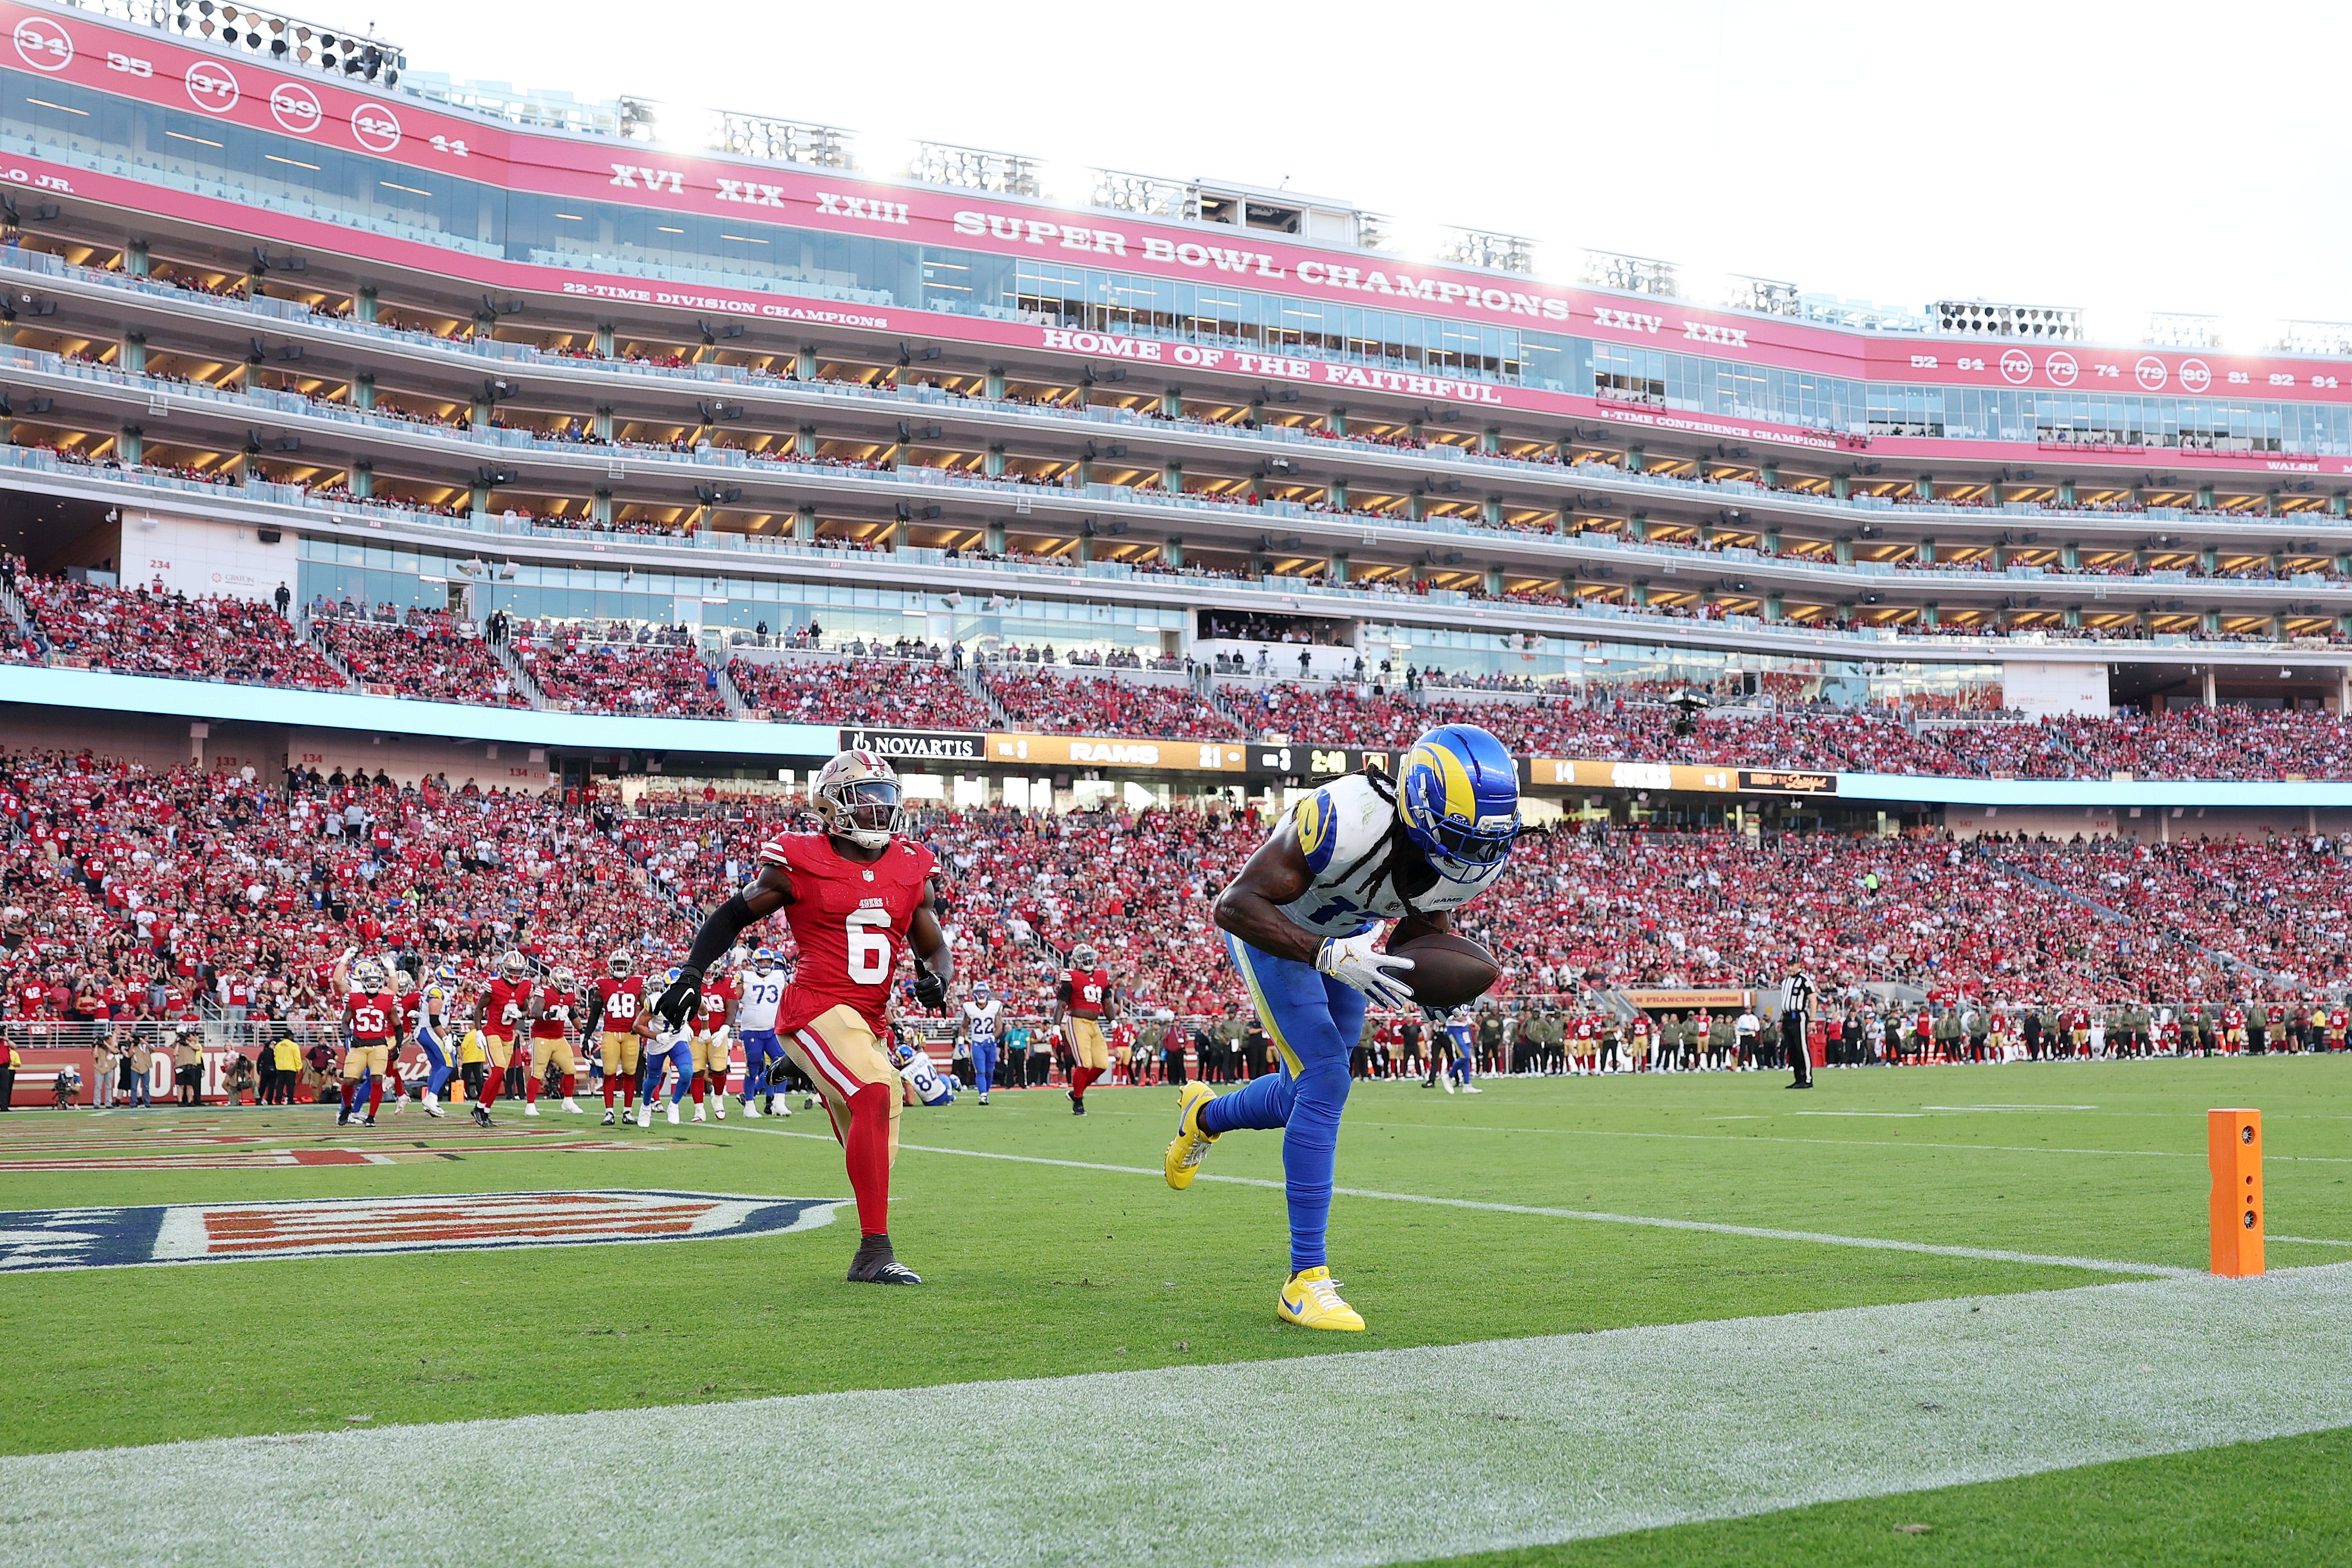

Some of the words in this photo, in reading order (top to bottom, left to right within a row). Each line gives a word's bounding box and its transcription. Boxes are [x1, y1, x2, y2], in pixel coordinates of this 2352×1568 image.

[19, 29, 67, 55] 34
[107, 52, 153, 78] 35
[191, 77, 234, 97] 37
[275, 96, 317, 117] 39
[356, 117, 396, 136] 42
[429, 135, 469, 156] 44
[35, 175, 75, 193] JR.
[609, 163, 684, 194] XVI
[714, 177, 785, 208] XIX
[816, 191, 908, 225] XXIII
[953, 210, 1127, 257] SUPER
[1142, 236, 1285, 279] BOWL
[1296, 260, 1570, 321] CHAMPIONS
[563, 282, 650, 301] 22-TIME
[656, 292, 757, 313] DIVISION
[762, 305, 888, 328] CHAMPIONS
[1593, 307, 1663, 334] XXIV
[1683, 320, 1748, 349] XXIX
[1042, 328, 1161, 361] HOME
[1174, 345, 1223, 367] OF
[1234, 351, 1311, 379] THE
[1325, 363, 1502, 404] FAITHFUL
[1911, 355, 1938, 369] 52
[2004, 359, 2030, 373] 70
[2049, 362, 2074, 375] 73
[2094, 364, 2119, 377] 74
[2139, 367, 2163, 379] 79
[1601, 410, 1654, 424] 8-TIME
[1656, 416, 1750, 437] CONFERENCE
[1752, 429, 1837, 449] CHAMPIONS
[2267, 461, 2319, 472] WALSH
[150, 560, 170, 569] 234
[875, 737, 973, 756] NOVARTIS
[1070, 742, 1159, 765] RAMS
[1199, 744, 1222, 768] 21
[216, 757, 237, 766] 133
[302, 754, 323, 763] 134
[1280, 748, 1291, 771] 3
[1311, 750, 1346, 773] 2:40
[510, 768, 528, 777] 134
[1555, 762, 1575, 783] 14
[113, 847, 124, 857] 16
[859, 897, 883, 908] 49ERS
[846, 908, 892, 984] 6
[25, 986, 41, 999] 42
[128, 982, 142, 992] 85
[233, 984, 246, 996] 85
[753, 984, 779, 1004] 73
[1084, 984, 1102, 1004] 91
[606, 993, 636, 1019] 48
[355, 1007, 385, 1032] 53
[973, 1017, 994, 1035] 22
[1634, 1024, 1646, 1034] 33
[1993, 1020, 2000, 1031] 9
[31, 1025, 47, 1035] 132
[1123, 1031, 1129, 1042] 7
[1578, 1024, 1590, 1036] 45
[914, 1065, 937, 1091] 84
